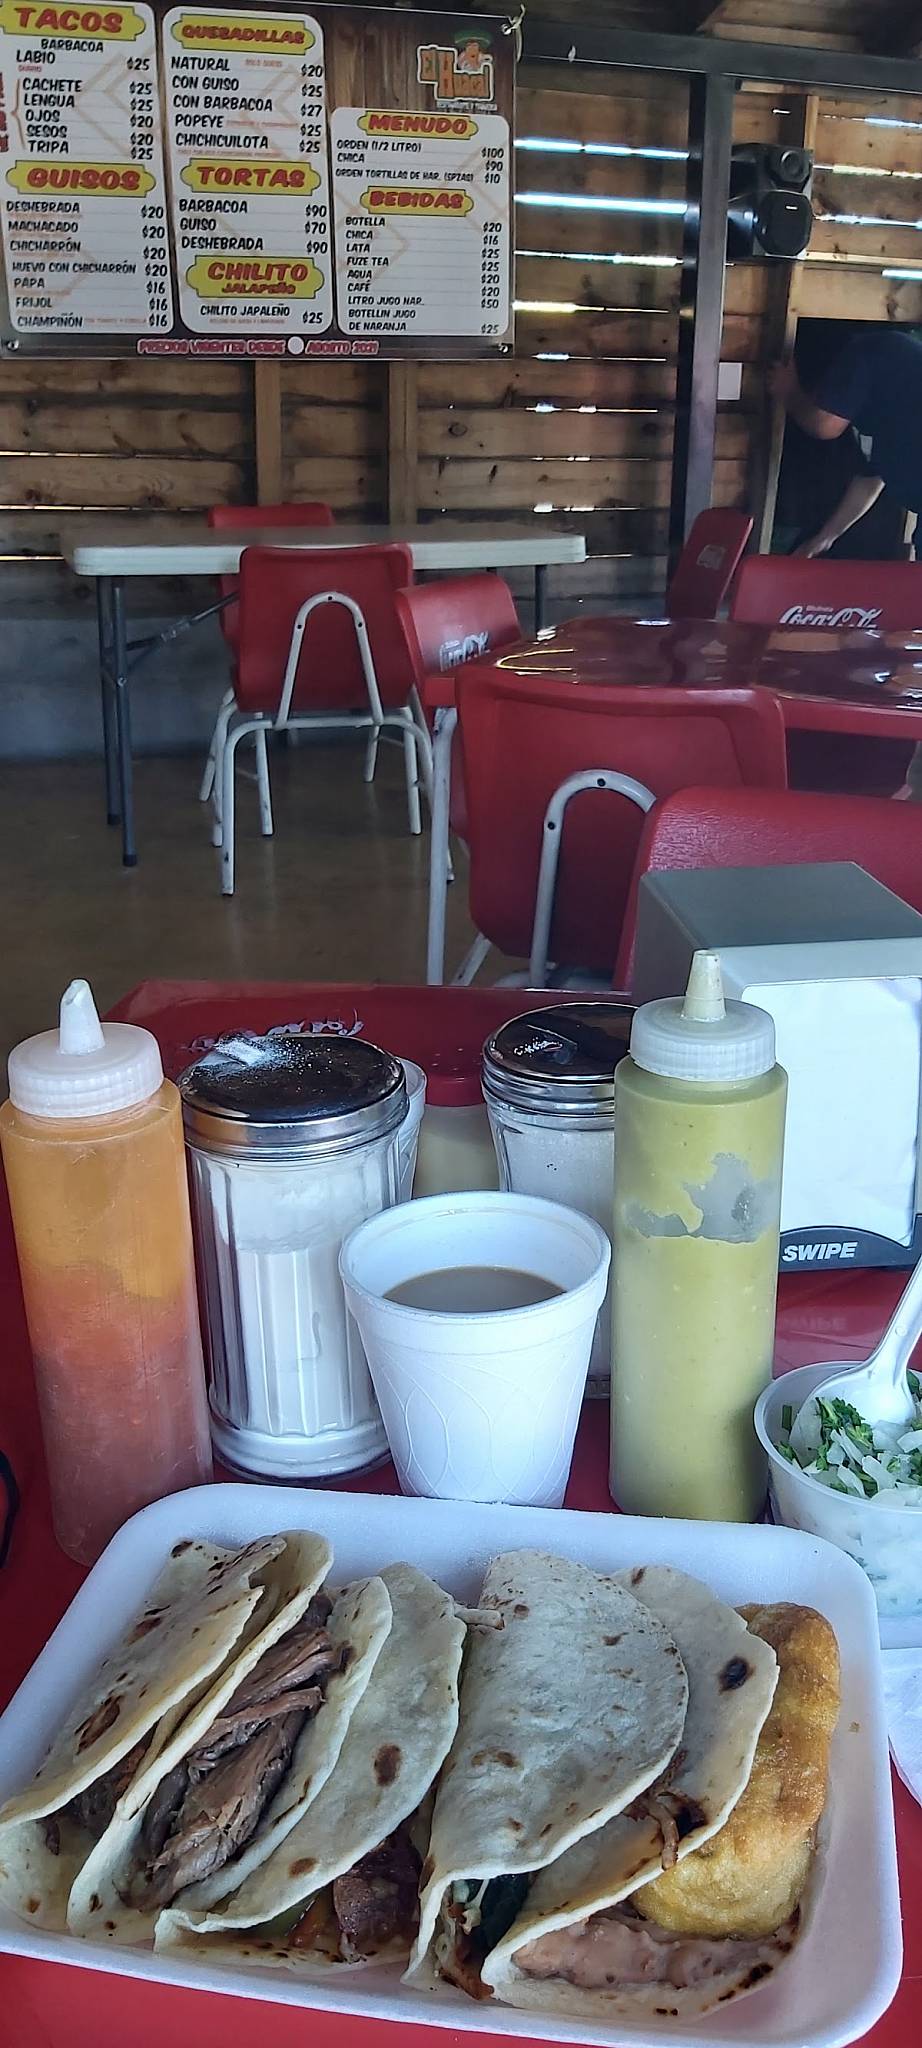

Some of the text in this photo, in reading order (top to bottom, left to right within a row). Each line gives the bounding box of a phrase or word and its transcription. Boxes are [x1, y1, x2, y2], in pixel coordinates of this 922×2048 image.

[14, 7, 123, 33] TACOS
[181, 25, 305, 44] QUESADILLAS
[41, 38, 104, 52] BARBACOA
[16, 50, 150, 70] LABIO $25
[171, 56, 230, 71] NATURAL
[301, 64, 323, 77] $20
[23, 78, 152, 95] CACHETE $25
[172, 75, 323, 97] CON GUISO $25
[24, 94, 153, 112] LENGUA $25
[173, 95, 323, 117] CON BARBACOA $27
[26, 109, 153, 128] OJOS $20
[175, 114, 224, 128] POPEYE
[300, 124, 321, 136] $25
[368, 115, 467, 134] MENUDO
[27, 124, 153, 145] SESOS $20
[176, 133, 268, 148] CHICHICUILOTA
[299, 140, 320, 153] $25
[28, 140, 153, 160] TRIPA $25
[337, 140, 504, 158] ORDEN (1/2 LITRO) $100
[337, 153, 503, 171] CHICA $90
[27, 168, 141, 191] GUISOS
[197, 166, 306, 188] TORTAS
[335, 169, 363, 177] ORDEN
[366, 170, 407, 179] TORTILLAS
[410, 171, 420, 180] DE
[485, 174, 500, 184] $10
[179, 199, 327, 217] BARBACOA $90
[369, 191, 464, 209] BEBIDAS
[6, 201, 164, 218] DESHEBRADA $20
[8, 221, 165, 239] MACHACADO $20
[180, 218, 326, 234] GUISO $70
[346, 217, 502, 233] BOTELLA $20
[182, 236, 328, 254] DESHEBRADA $90
[346, 230, 499, 245] CHICA $16
[10, 238, 166, 260] CHICHARRÓN $20
[346, 244, 500, 258] LATA $25
[12, 260, 167, 277] HUEVO CON CHICHARRÓN $20
[207, 262, 308, 281] CHILITO
[347, 257, 500, 272] FUZE TEA $25
[14, 278, 165, 294] PAPA $16
[347, 270, 500, 284] AGUA $20
[221, 282, 296, 294] JALAPEÑO
[347, 280, 500, 297] CAFÉ $20
[16, 297, 167, 311] FRIJOL $16
[348, 296, 374, 305] LITRO
[377, 296, 400, 305] JUGO
[481, 299, 499, 309] $50
[149, 314, 167, 327] $16
[200, 303, 323, 324] CHILITO JAPALEÑO $25
[348, 309, 416, 318] BOTELLIN JUGO
[349, 322, 499, 334] DE NARANJA $25
[782, 1242, 858, 1261] SWIPE
